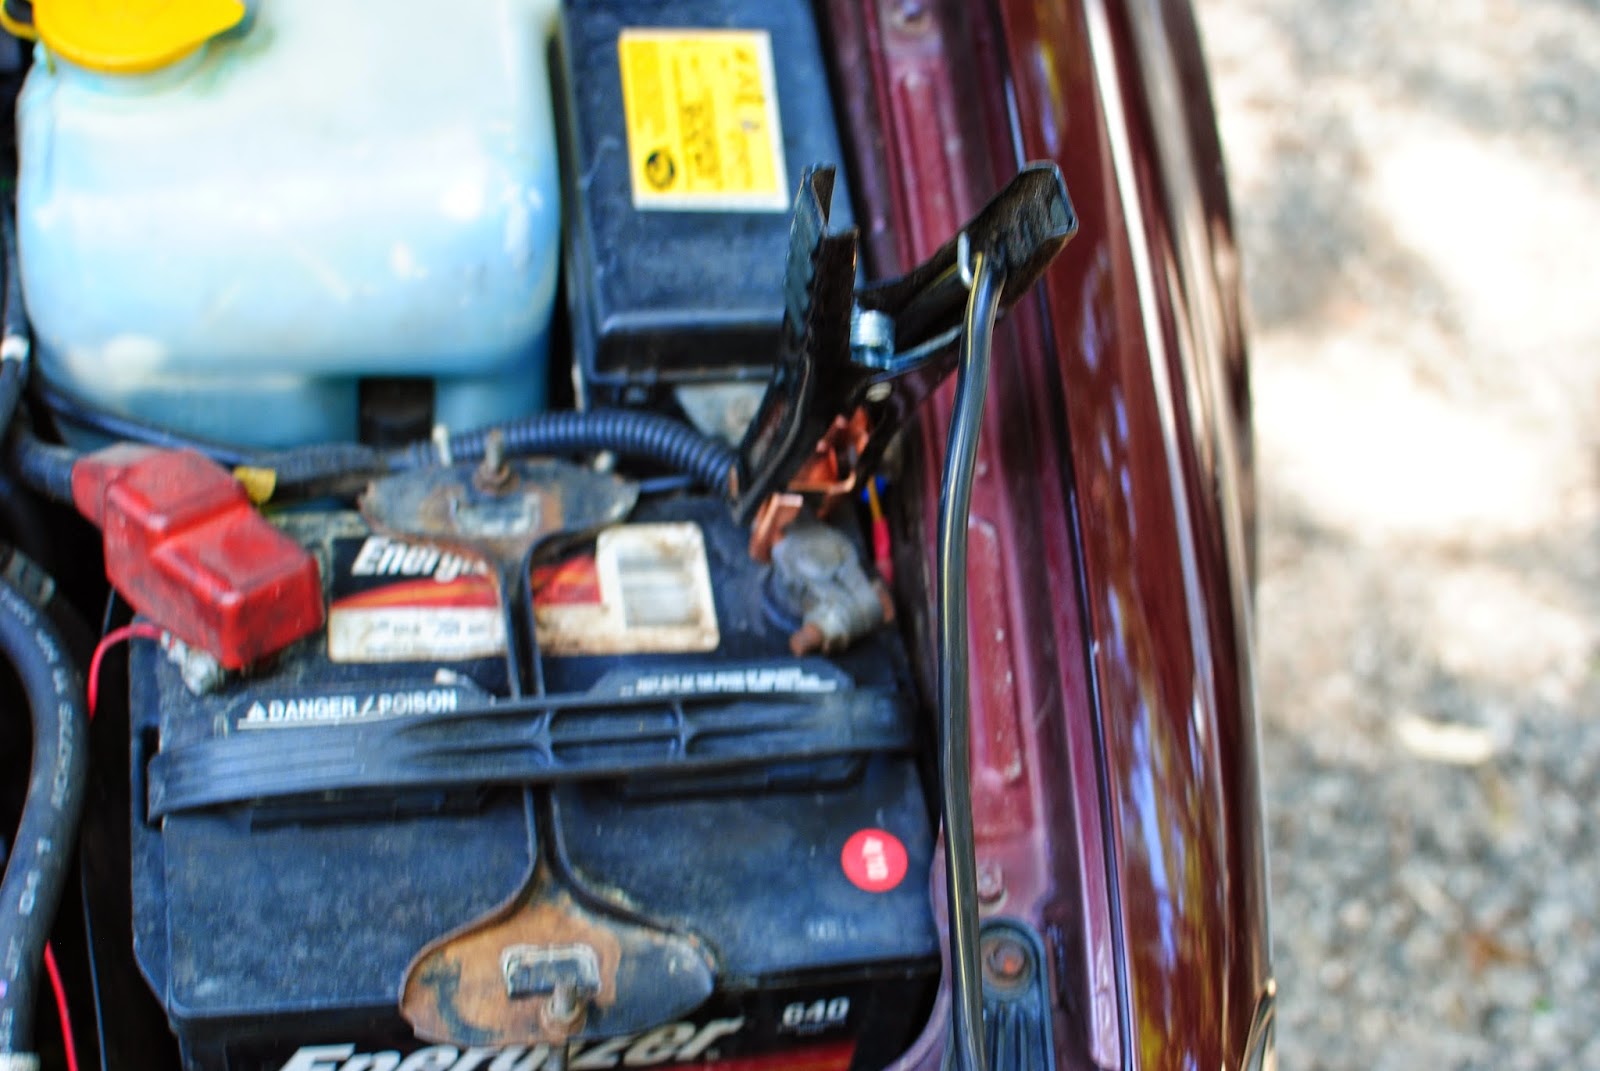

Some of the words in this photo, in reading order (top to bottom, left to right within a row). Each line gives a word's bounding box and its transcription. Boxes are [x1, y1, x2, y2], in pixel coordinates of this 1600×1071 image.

[268, 695, 356, 722] DANGER
[377, 688, 457, 715] POISON
[279, 1015, 745, 1071] Energzer
